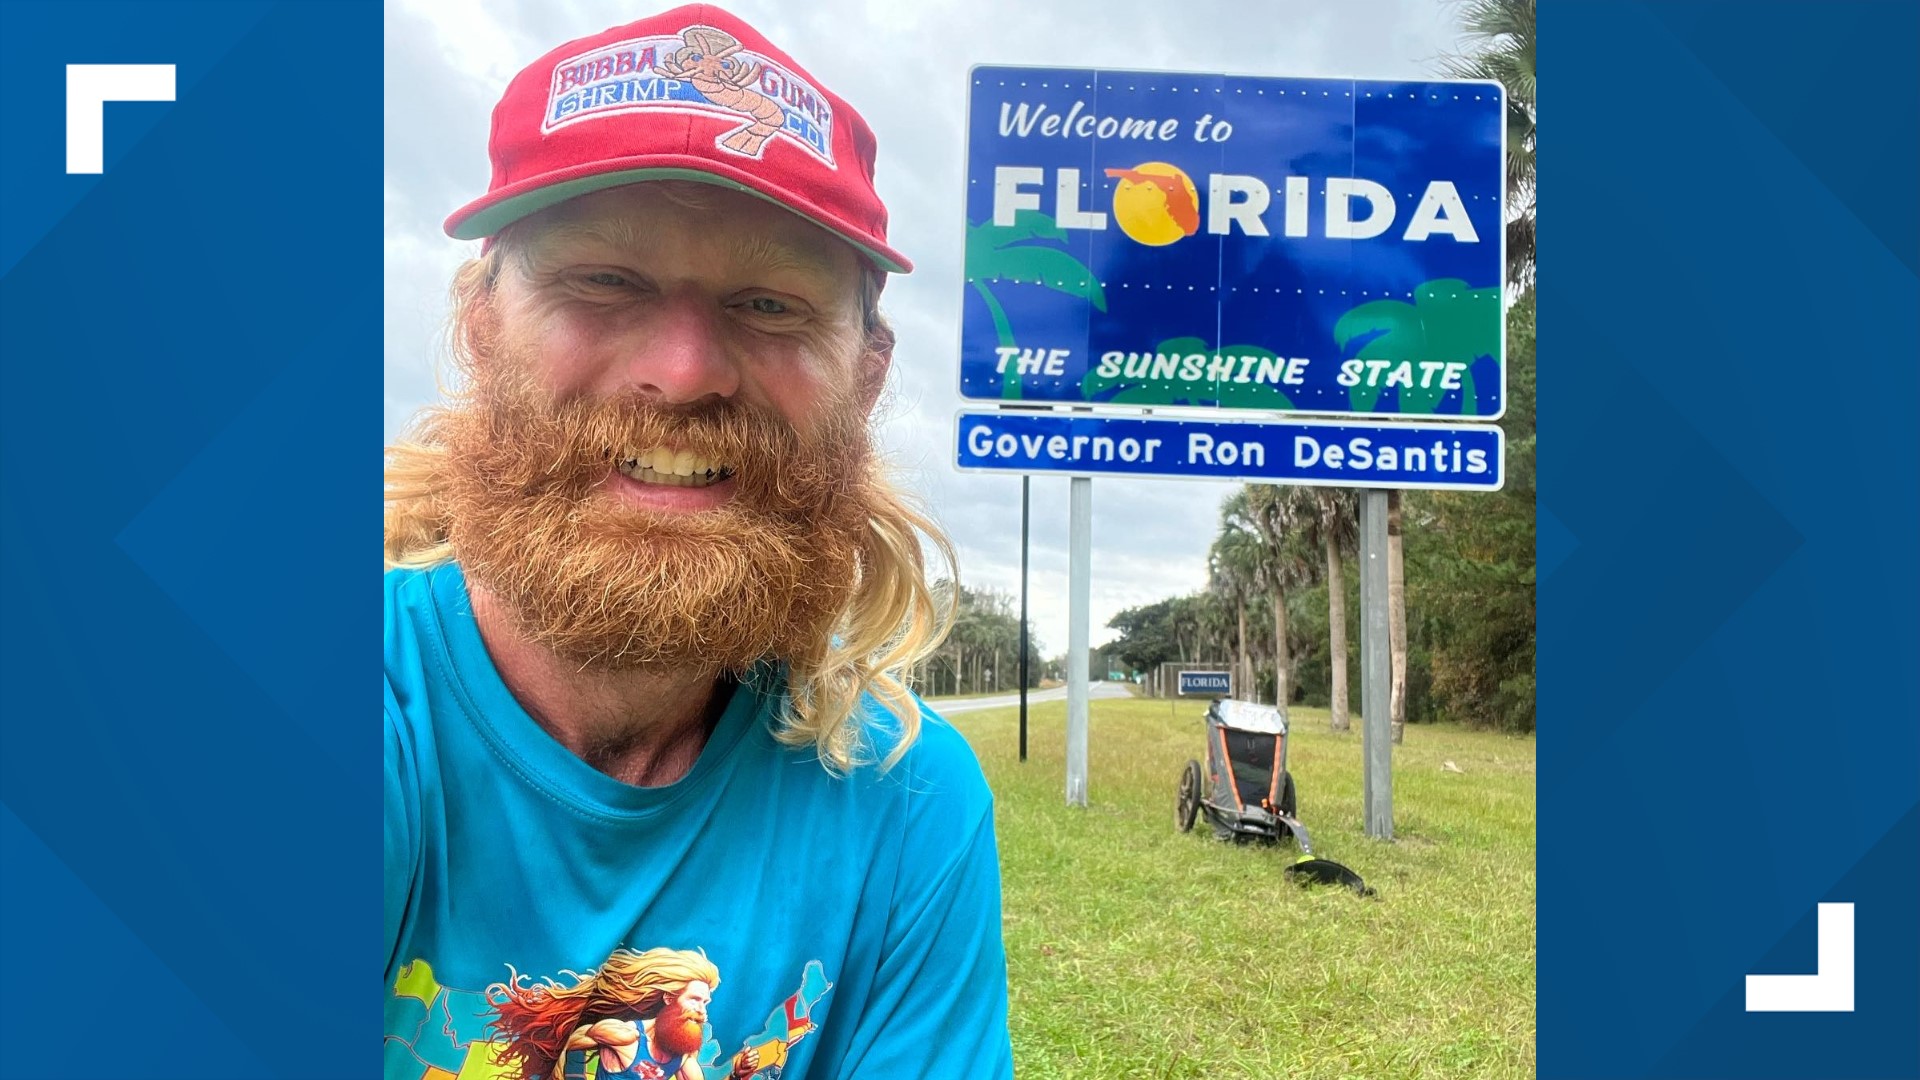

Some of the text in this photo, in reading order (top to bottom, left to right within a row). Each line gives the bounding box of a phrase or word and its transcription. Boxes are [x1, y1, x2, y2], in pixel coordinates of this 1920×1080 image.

[557, 46, 829, 126] BUBBA GUMP
[560, 80, 820, 147] SHRIMP CO
[998, 101, 1233, 143] Welcome to
[993, 161, 1480, 248] FLORIDA
[995, 347, 1467, 390] THE SUNSHINE STATE
[967, 425, 1488, 474] Governor Ron DeSantis
[1181, 677, 1228, 688] FLORIDA
